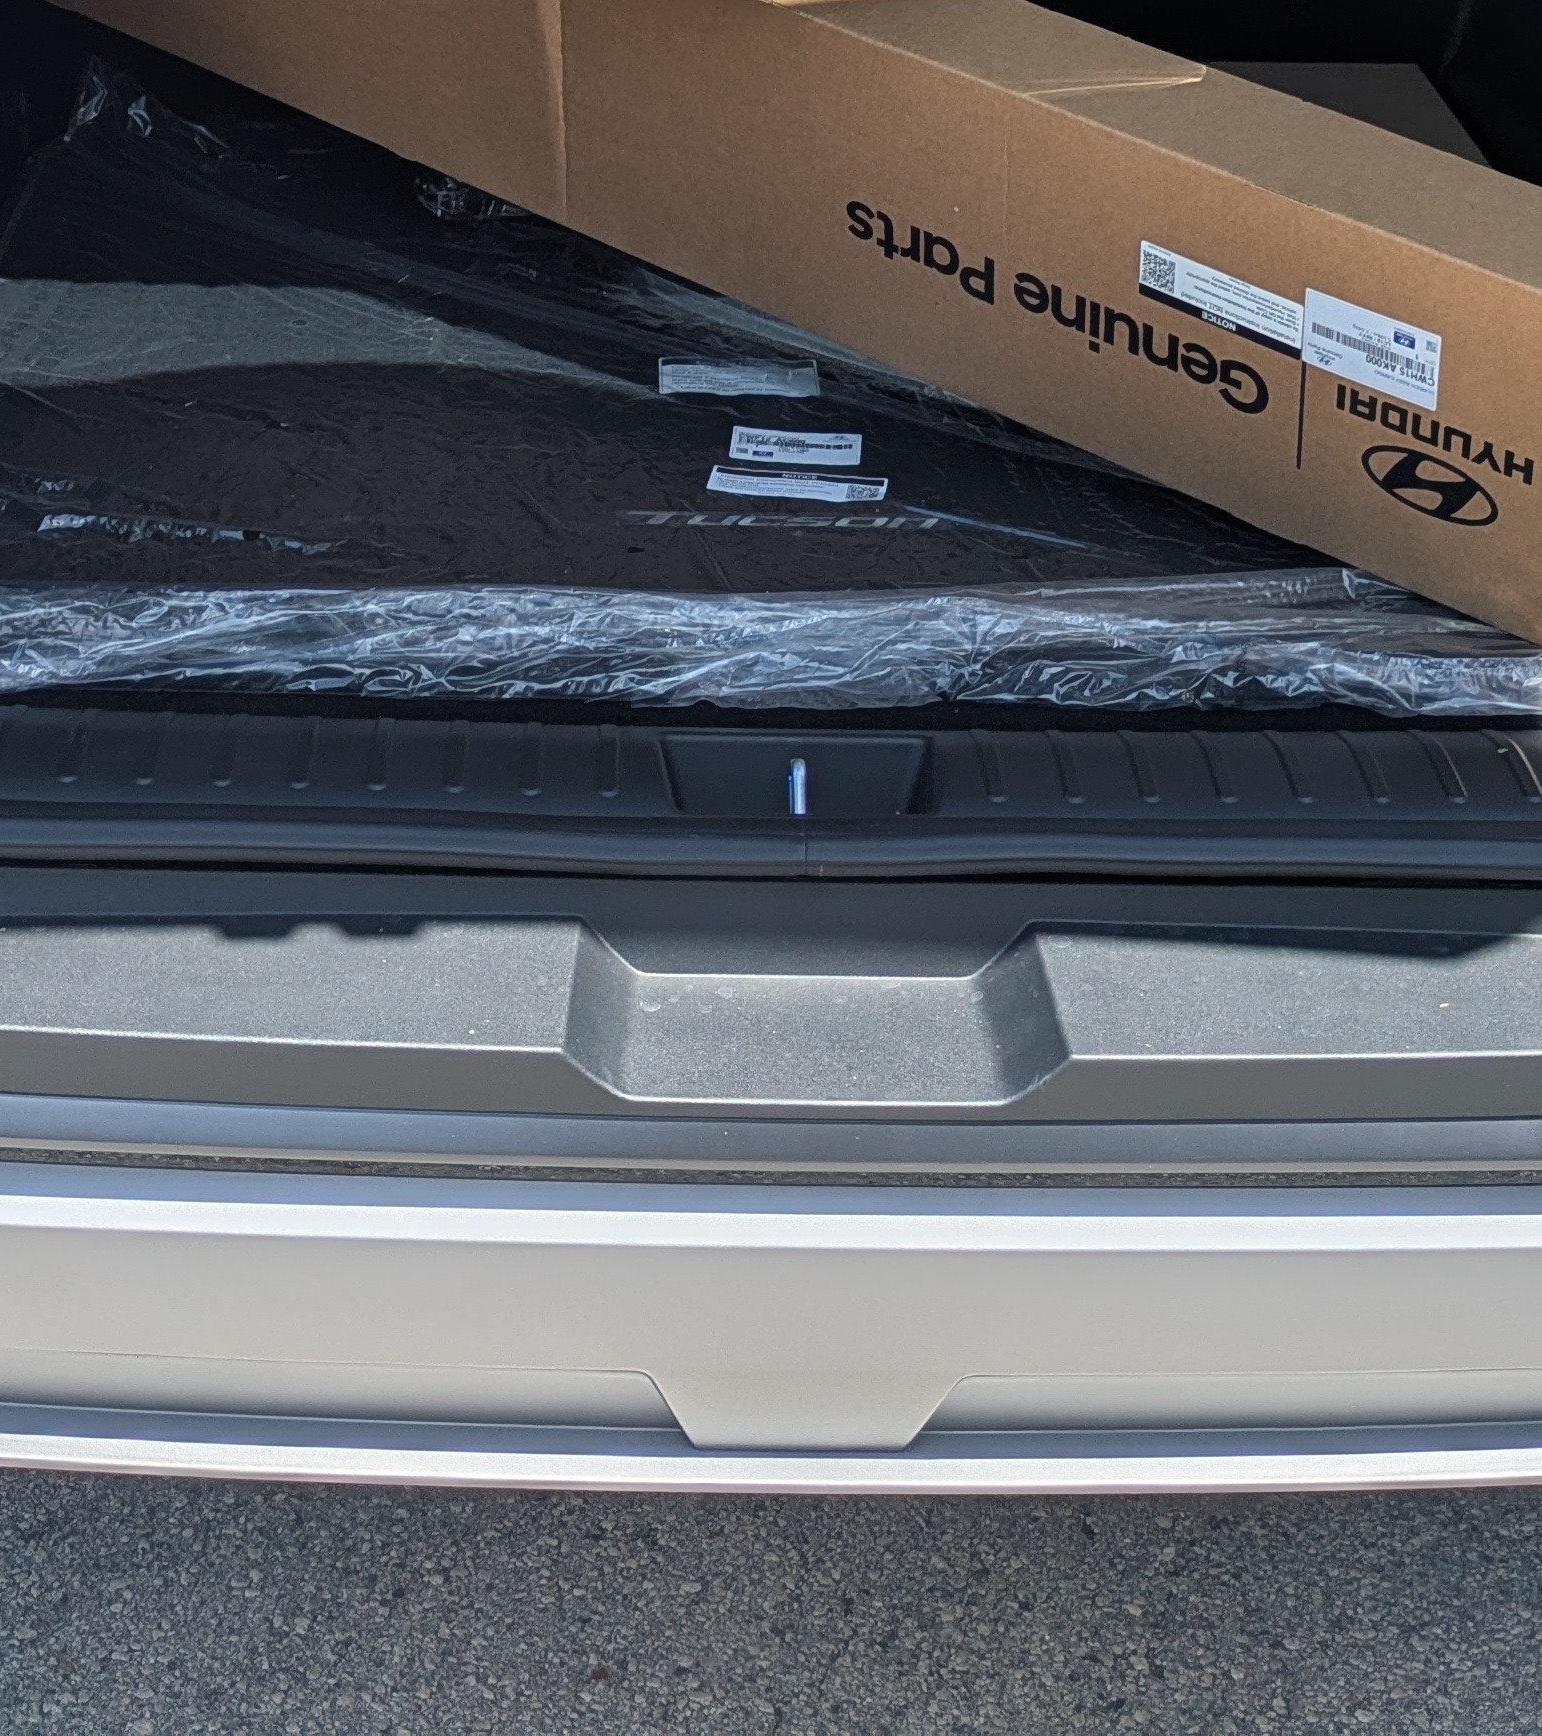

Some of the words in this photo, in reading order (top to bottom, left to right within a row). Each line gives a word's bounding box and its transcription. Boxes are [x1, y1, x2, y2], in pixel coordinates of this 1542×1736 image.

[846, 201, 995, 305] Parts
[1014, 272, 1270, 414] Genuine
[1201, 310, 1237, 332] NOTICE
[1399, 368, 1436, 387] CWH15
[1336, 383, 1535, 485] HYUNDAI
